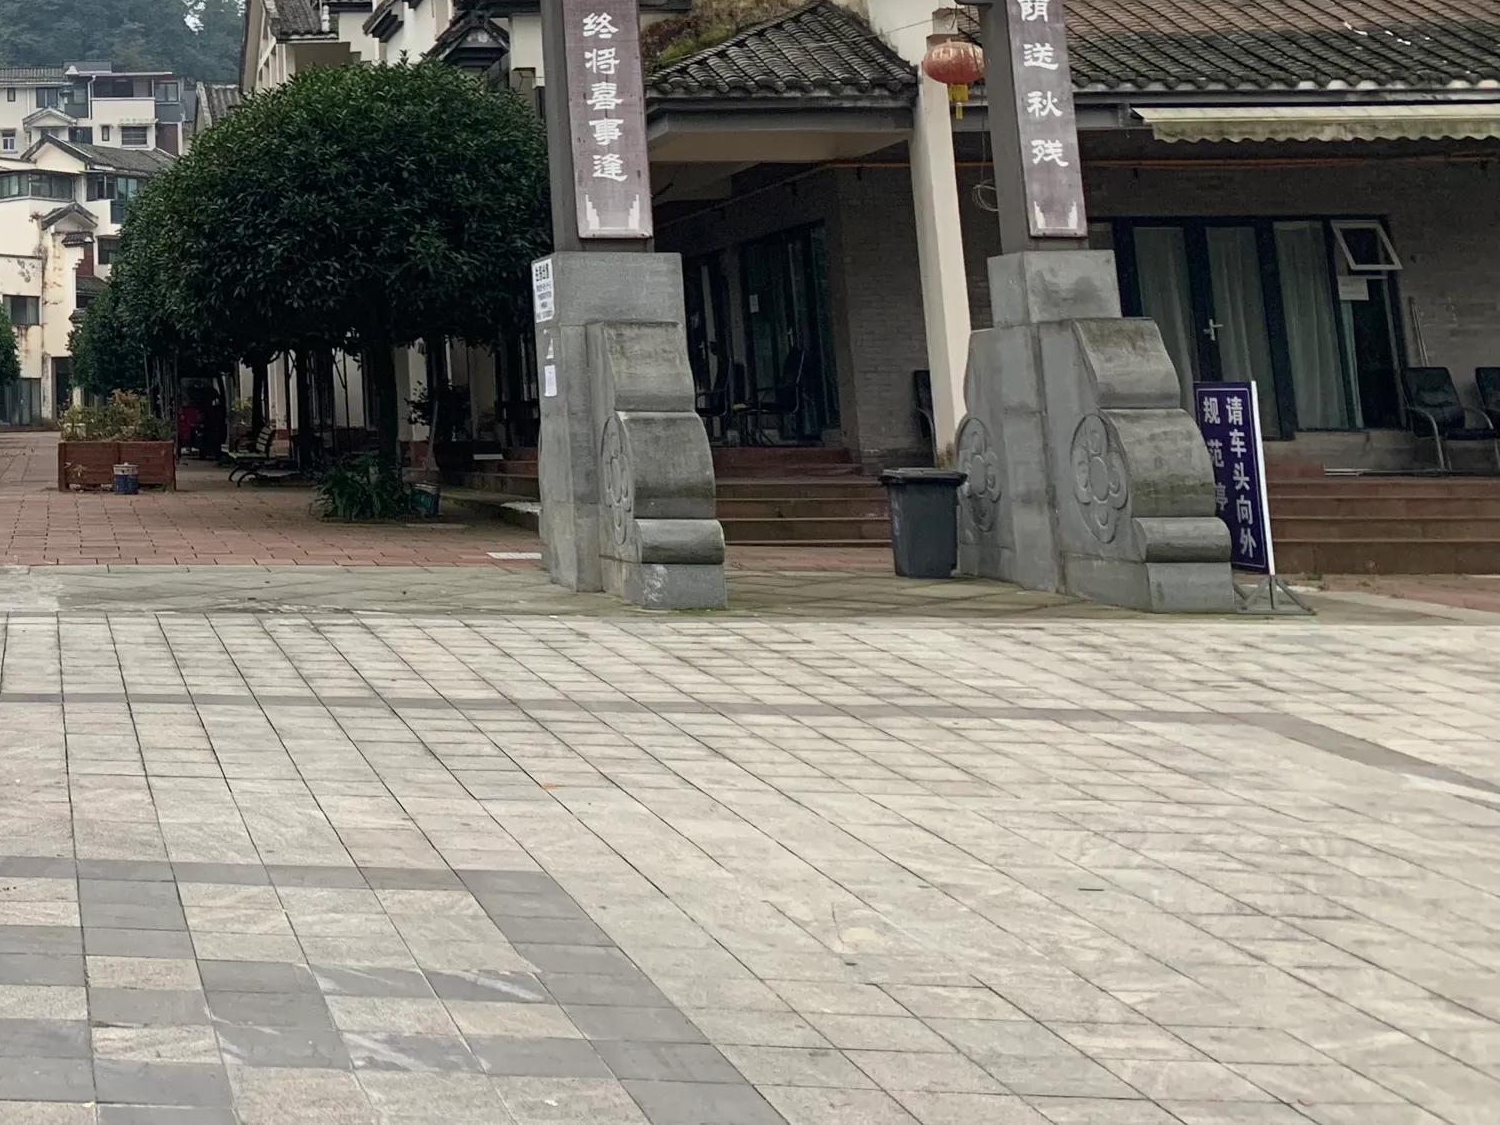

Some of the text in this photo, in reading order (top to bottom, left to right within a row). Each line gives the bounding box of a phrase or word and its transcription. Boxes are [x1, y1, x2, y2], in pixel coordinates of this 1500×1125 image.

[1224, 394, 1258, 560] 请车头向外
